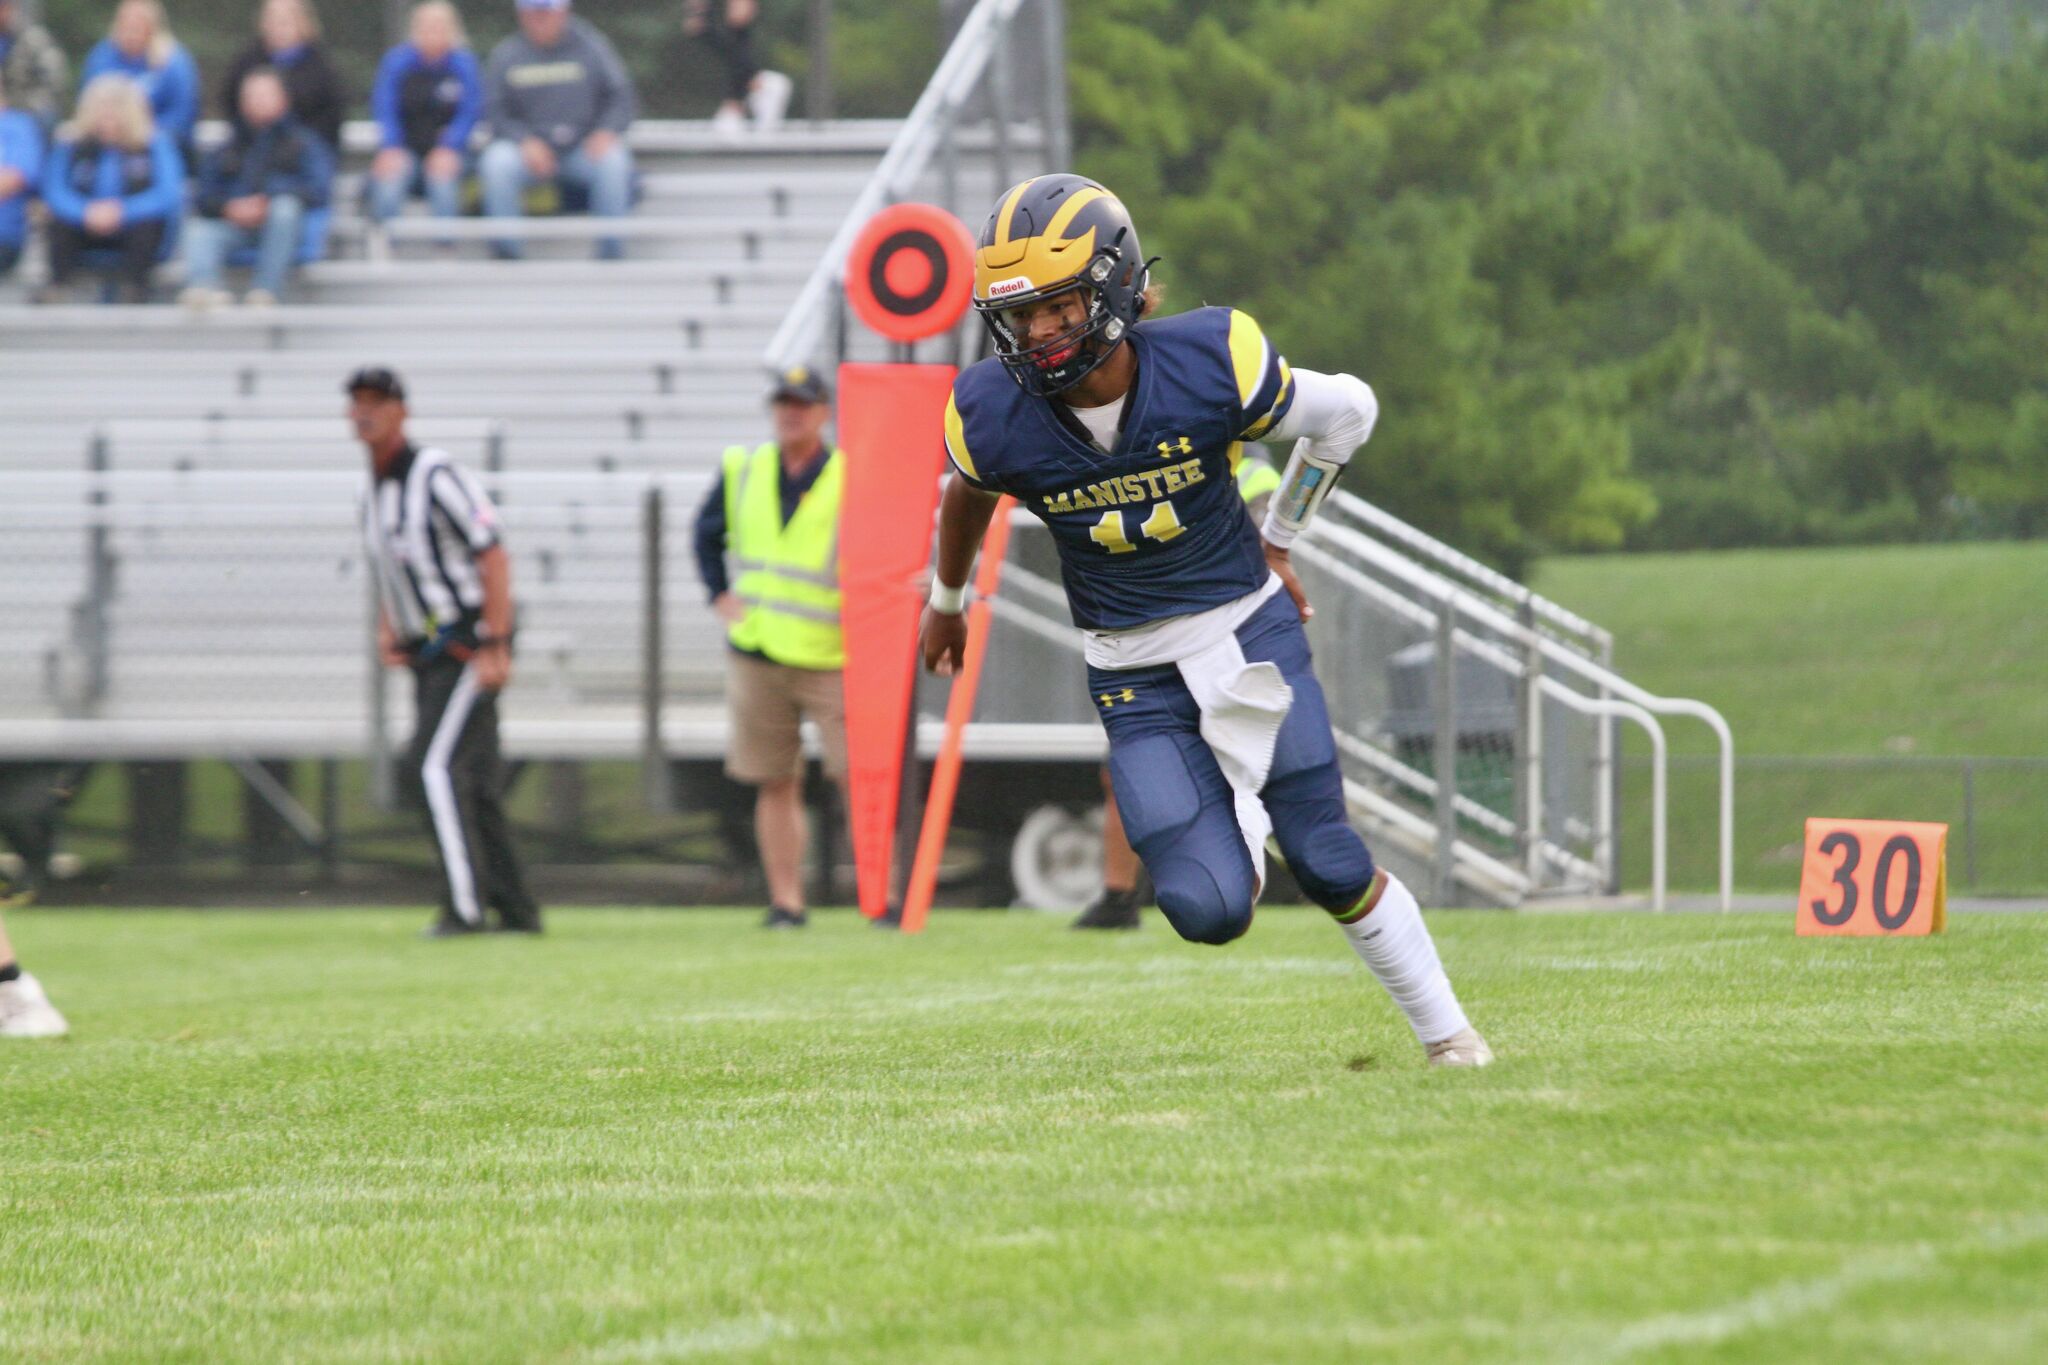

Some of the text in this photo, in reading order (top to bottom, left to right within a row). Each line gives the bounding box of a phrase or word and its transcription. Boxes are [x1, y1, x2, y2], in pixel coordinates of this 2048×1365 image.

[991, 281, 1024, 296] Riddell
[1043, 458, 1205, 513] MANISTEE
[1089, 500, 1187, 554] 11
[1811, 831, 1921, 930] 30
